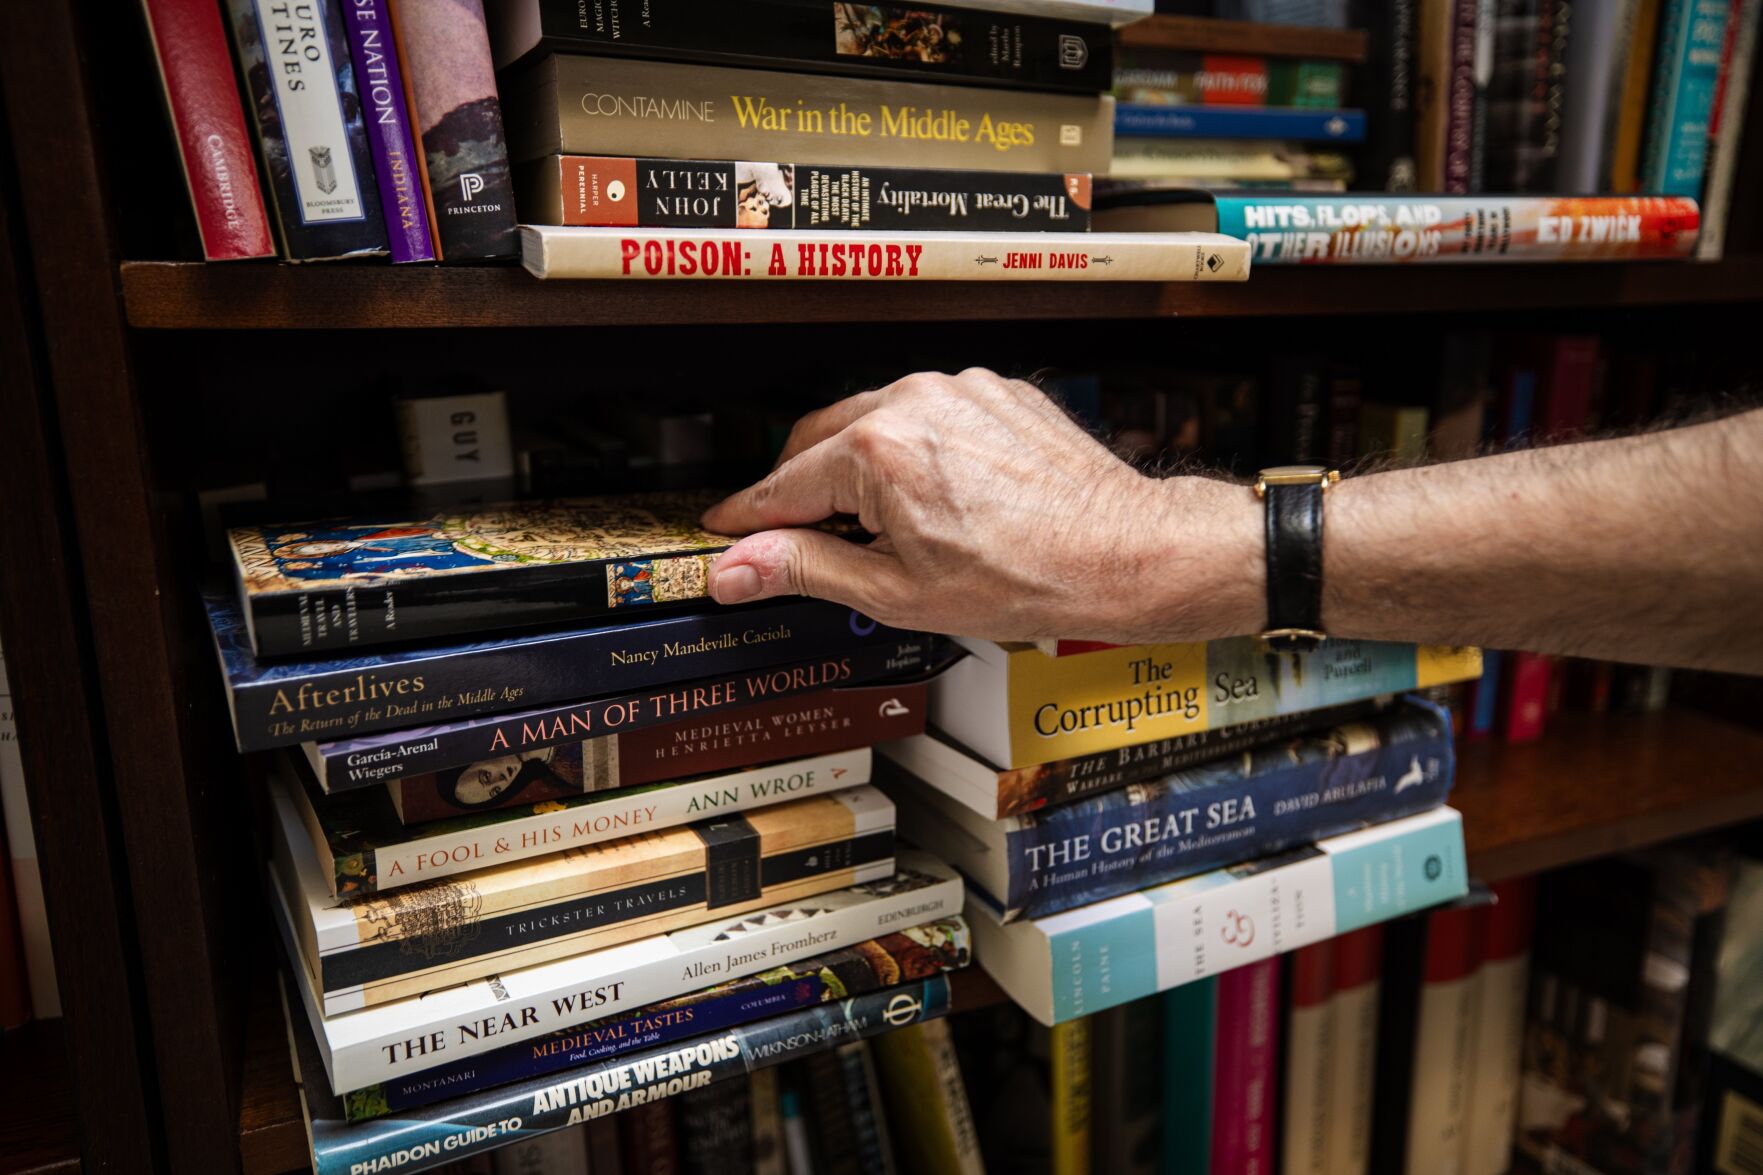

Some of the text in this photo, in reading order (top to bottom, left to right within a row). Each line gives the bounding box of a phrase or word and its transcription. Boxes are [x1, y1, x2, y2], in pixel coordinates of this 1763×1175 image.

[272, 2, 306, 91] TINES
[360, 30, 396, 124] NATION
[581, 93, 1034, 150] CONTAMINE War in the Middle Ages
[207, 134, 239, 229] CAMBRIDGE
[306, 199, 354, 208] BLOOMSBURY
[389, 152, 413, 229] INDIANA
[646, 170, 728, 191] KELLY
[800, 189, 809, 206] TIME
[811, 170, 819, 224] PLAGUE OF ALL
[821, 174, 829, 222] DEVASTATING
[831, 181, 840, 216] THE MOST
[841, 174, 850, 223] BLACK DEATH,
[851, 170, 860, 228] HISTORY OF THE
[861, 177, 870, 221] AN INTIMATE
[877, 182, 1070, 220] The Great Mortality
[322, 207, 344, 215] PRESS
[448, 204, 501, 215] PRINCETON
[656, 197, 720, 217] JOHN
[1244, 205, 1315, 229] HITS,
[1395, 205, 1442, 225] AND
[1538, 213, 1642, 242] ED ZWICK
[621, 239, 923, 277] POISON: A HISTORY
[1003, 252, 1088, 269] JENNI DAVIS
[1247, 231, 1331, 259] OTHER
[1334, 230, 1442, 258] ILLUSIONS
[450, 411, 480, 464] GUY
[332, 604, 342, 629] AND
[610, 625, 792, 667] Nancy Mandeville Caciola
[268, 673, 425, 715] Afterlives
[1129, 657, 1173, 685] The
[268, 686, 524, 736] The Return of the Dead in the Middle Ages
[489, 659, 852, 752] A MAN OF THREE WORLDS
[675, 707, 834, 743] MEDIEVAL WOMEN
[1034, 685, 1200, 737] Corrupting
[1214, 672, 1259, 703] Sea
[347, 738, 439, 767] García-Arenal
[655, 717, 851, 759] HENRIETTA LEYSER
[1069, 761, 1107, 778] THE
[1118, 730, 1209, 766] BARBARY
[349, 762, 404, 782] Wiegers
[1066, 772, 1123, 794] WARFARE
[388, 770, 815, 878] A FOOL & HIS MONEY ANN WROE
[1024, 834, 1091, 873] THE
[1100, 808, 1199, 854] GREAT
[1205, 795, 1257, 829] SEA
[1273, 791, 1320, 817] DAVID
[1028, 825, 1256, 891] A Human History of the Mediterranean
[505, 886, 687, 936] TRICKSTER TRAVELS
[877, 899, 944, 927] EDINBURGH
[1220, 909, 1255, 948] &
[681, 928, 838, 982] Allen James Fromherz
[1193, 905, 1205, 976] THE SEA
[1072, 940, 1084, 1015] LINCOLN
[1099, 944, 1111, 993] PAINE
[382, 981, 625, 1065] THE NEAR WEST
[402, 994, 786, 1096] MONTANARI MEDIEVAL TASTES COLUMBIA
[569, 1032, 661, 1062] Food, Cooking, and the Table
[532, 1017, 868, 1117] ANTIQUE WEAPONS WILKINSON-LATHAM
[566, 1070, 712, 1126] AND ARMOUR
[351, 1116, 523, 1175] PHAIDON GUIDE TO
